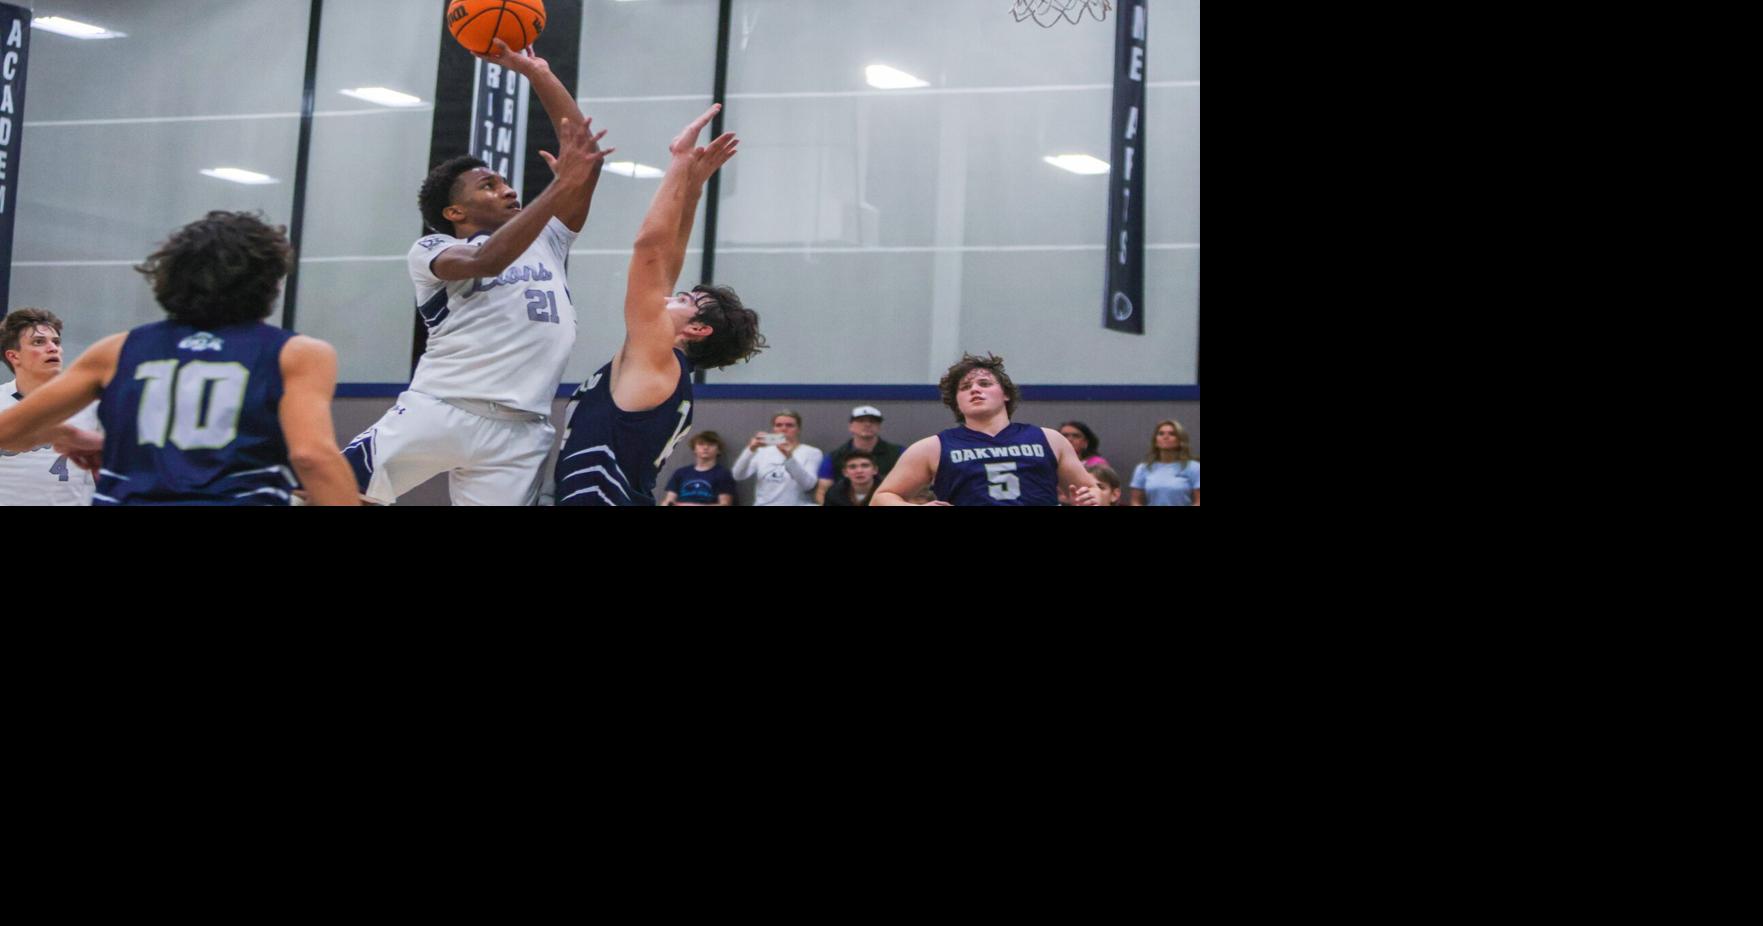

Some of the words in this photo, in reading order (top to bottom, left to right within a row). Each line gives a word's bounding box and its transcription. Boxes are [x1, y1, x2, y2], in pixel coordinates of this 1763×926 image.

[524, 289, 560, 324] 21
[134, 359, 250, 451] 10
[49, 455, 69, 482] 4
[950, 444, 1045, 463] OAKWOOD
[984, 462, 1021, 500] 5
